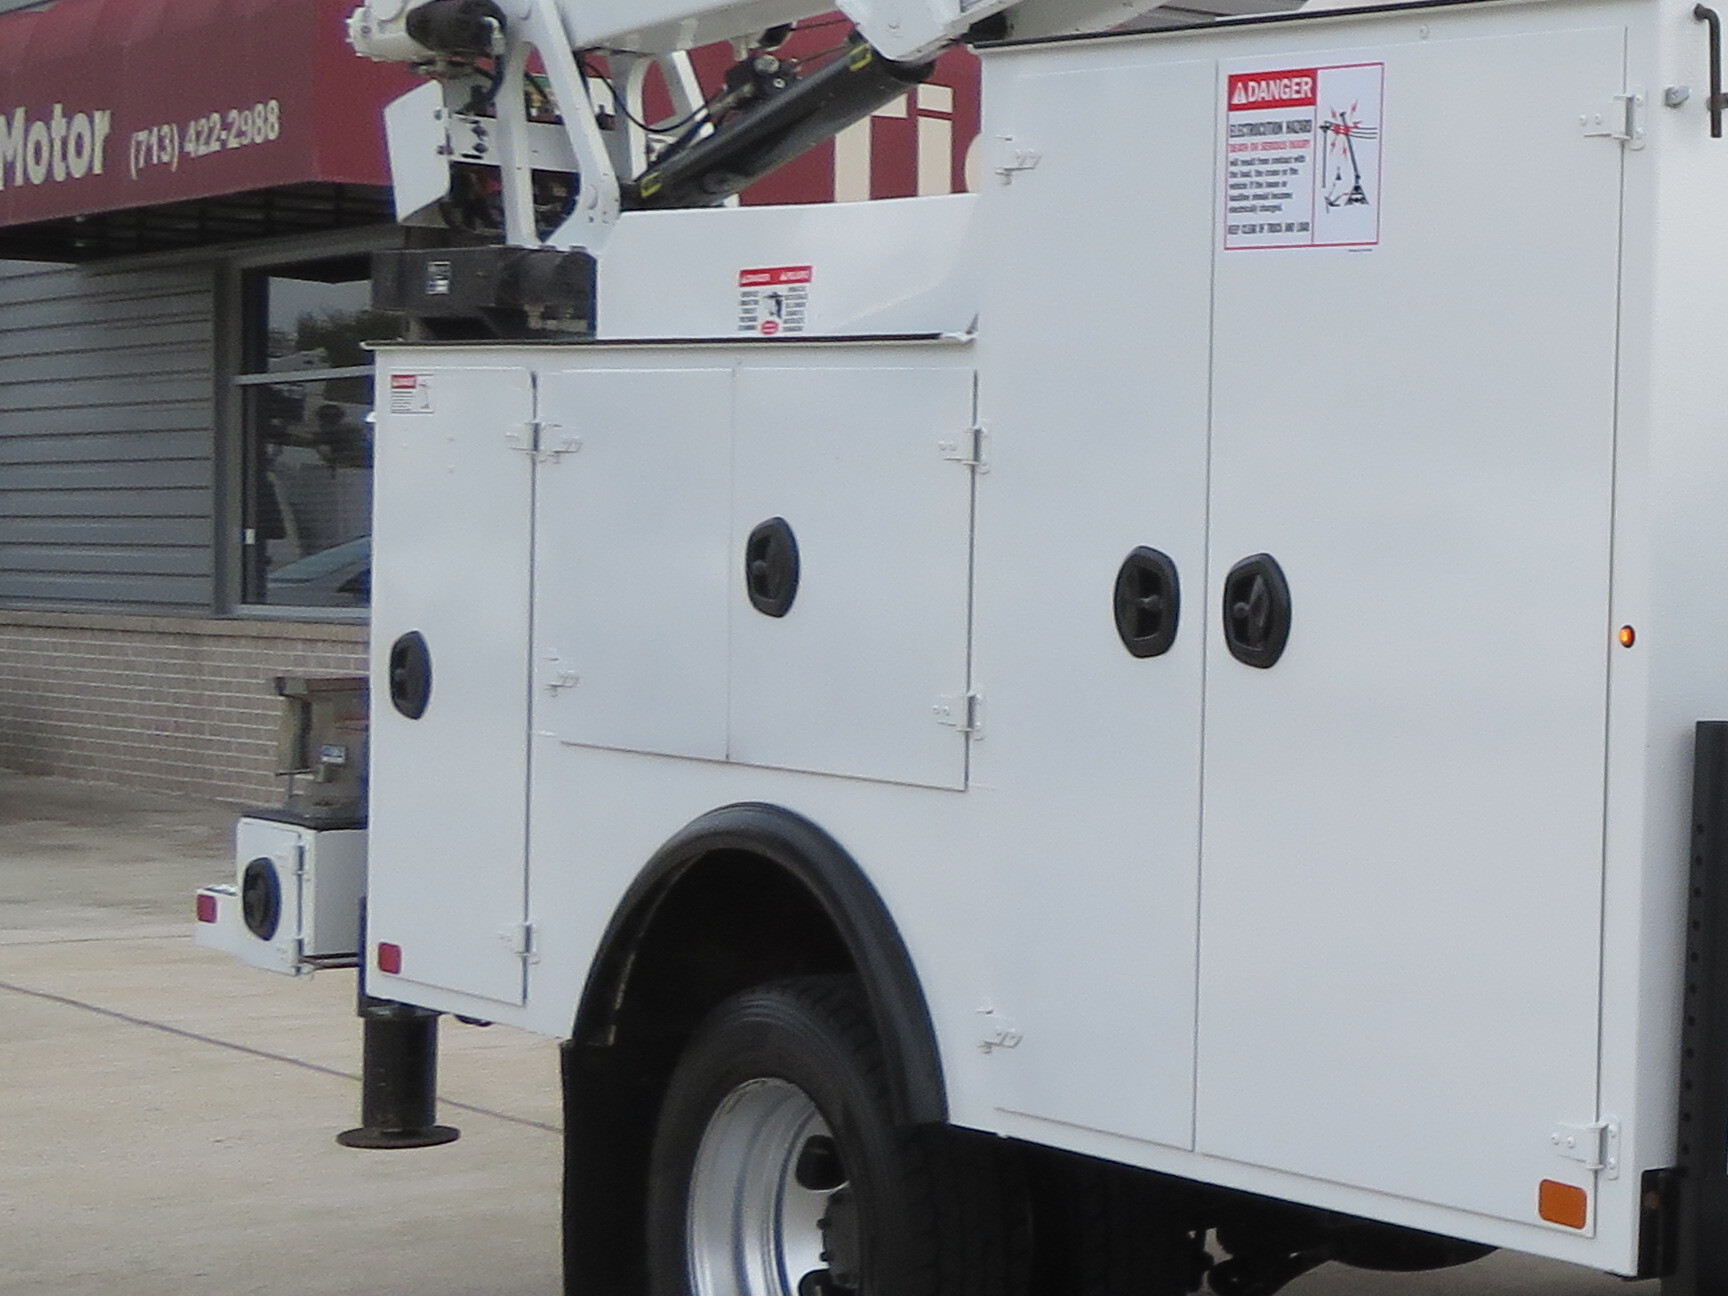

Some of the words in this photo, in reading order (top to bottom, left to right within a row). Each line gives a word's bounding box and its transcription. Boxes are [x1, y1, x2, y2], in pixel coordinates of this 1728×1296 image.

[1248, 76, 1312, 102] DANGER
[0, 102, 110, 190] Motor
[130, 123, 179, 180] (713)
[183, 99, 280, 158] 422-2988
